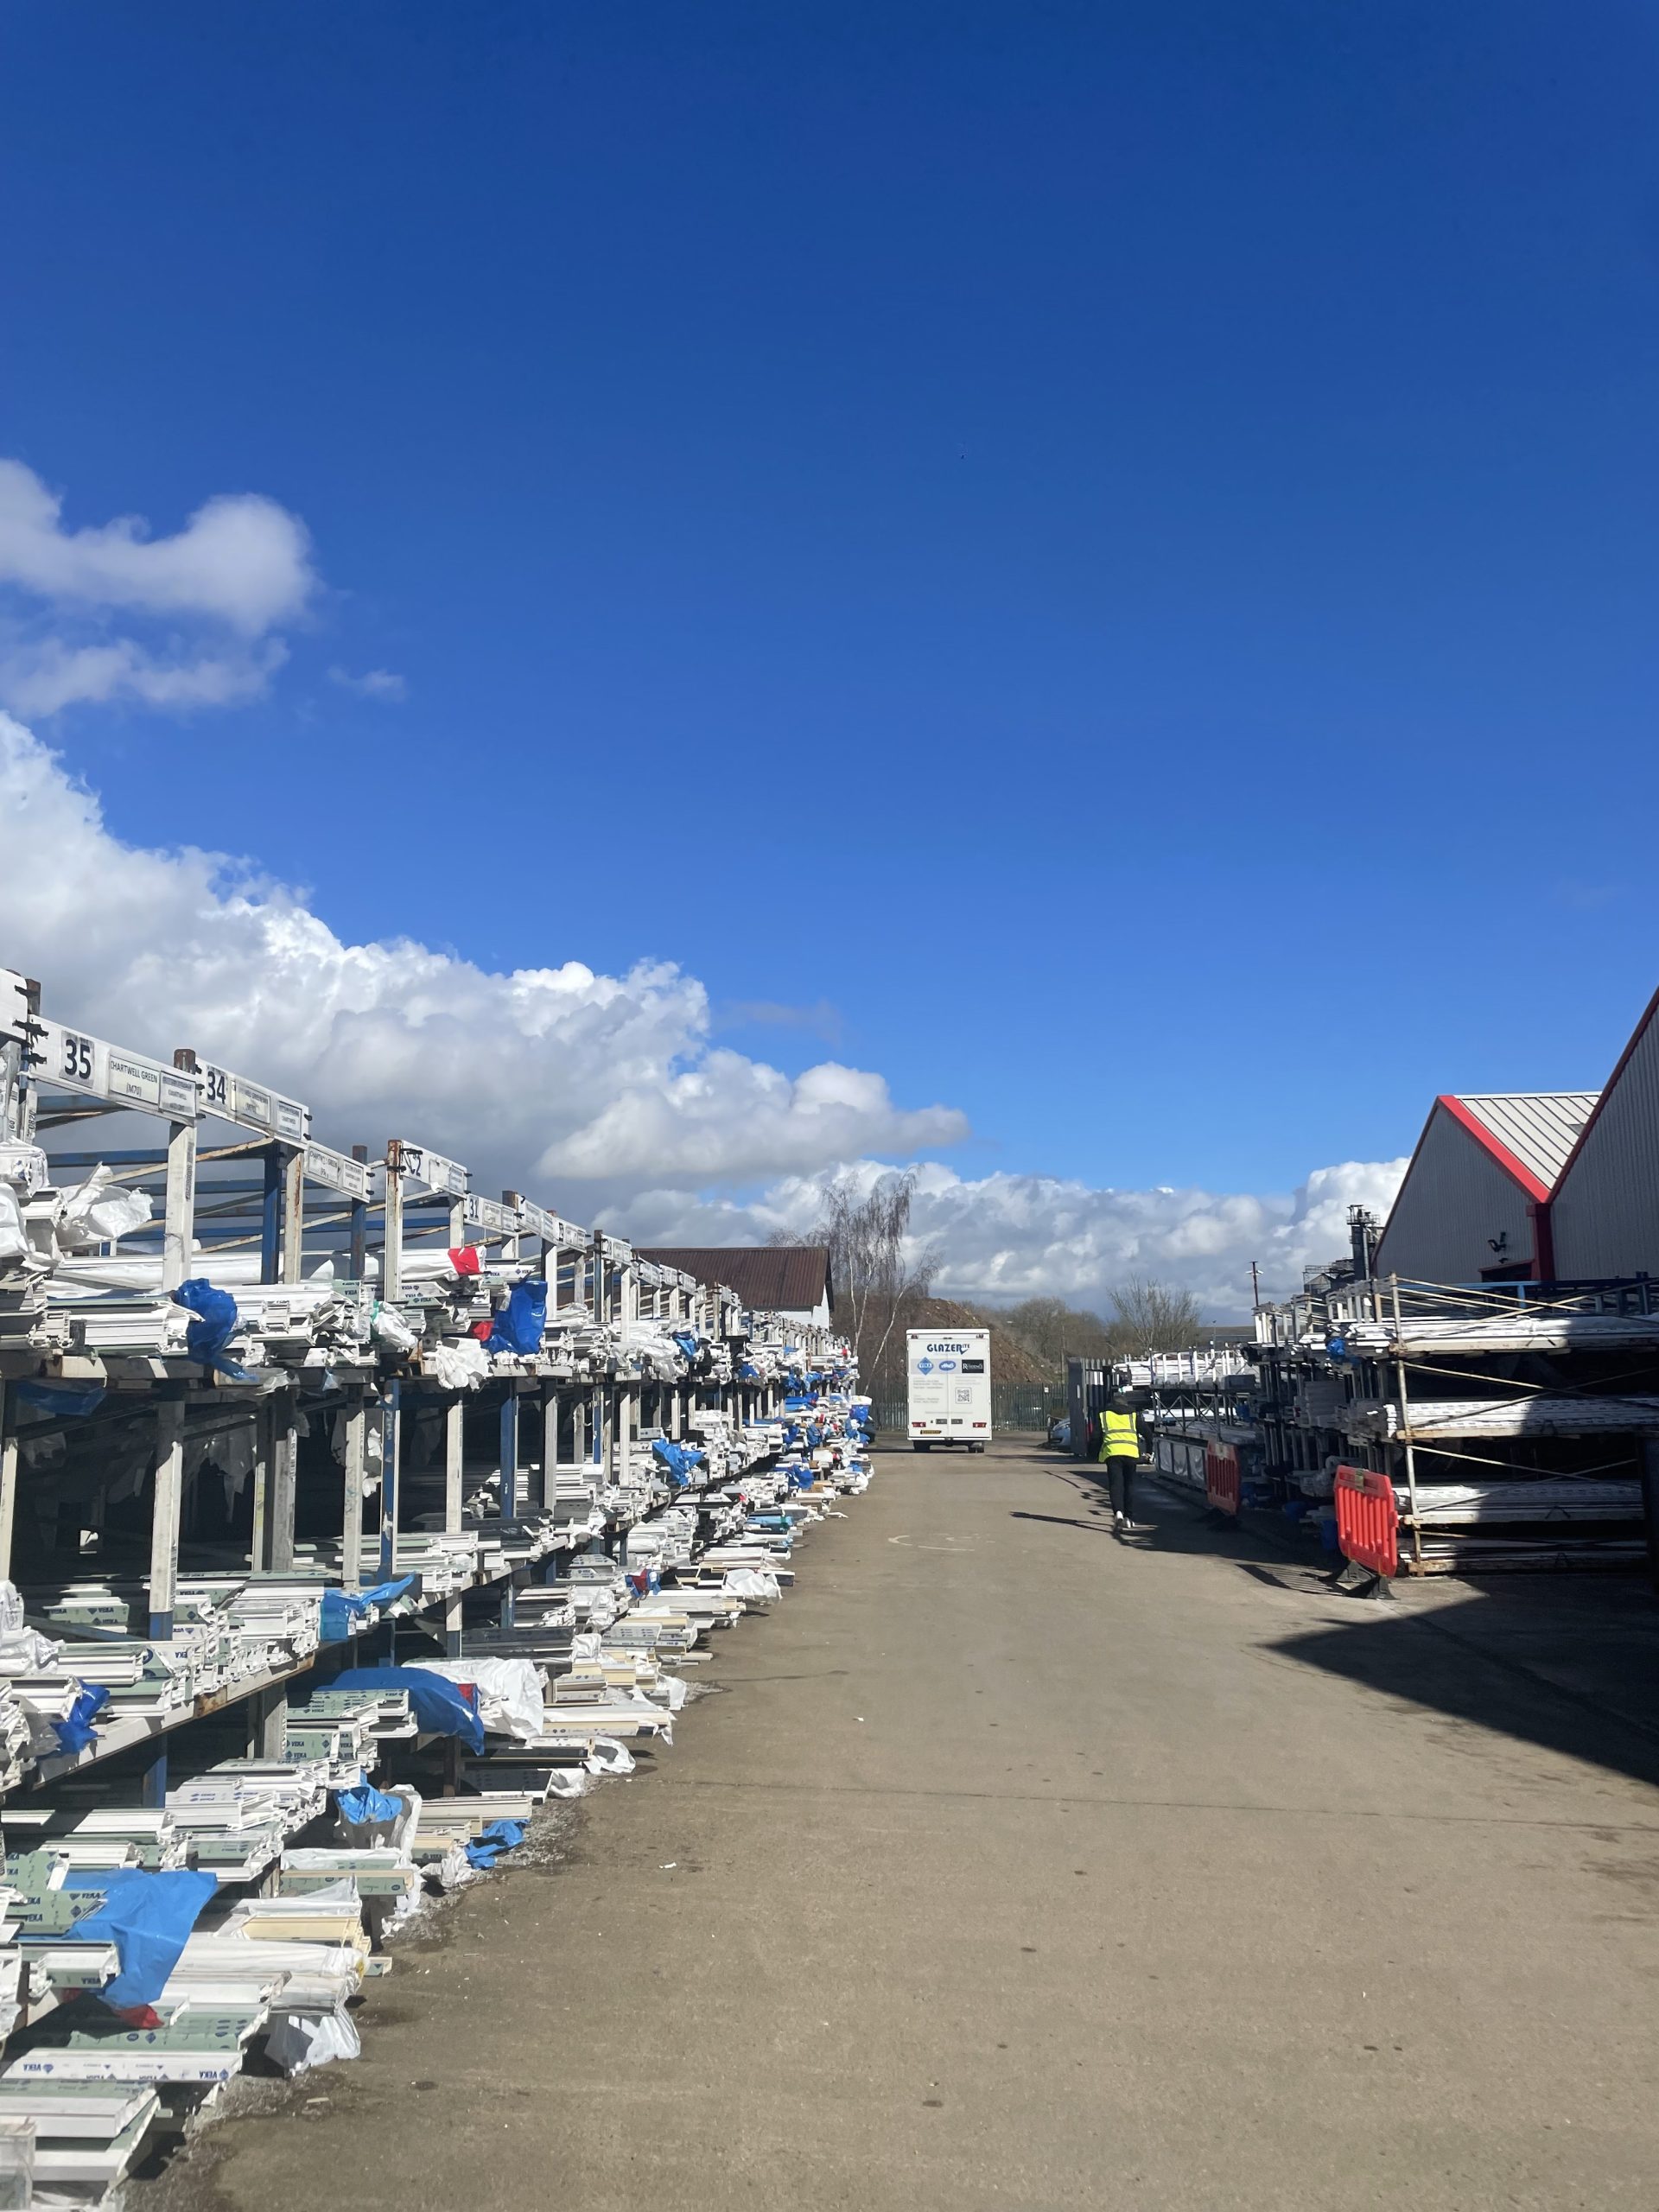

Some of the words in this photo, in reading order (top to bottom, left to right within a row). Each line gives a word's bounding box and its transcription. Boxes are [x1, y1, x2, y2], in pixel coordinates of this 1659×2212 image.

[65, 1039, 91, 1079] 35
[110, 1060, 141, 1078] CHARTWELL
[141, 1071, 158, 1084] GREEN
[207, 1071, 226, 1104] 34
[470, 1198, 479, 1218] 31
[200, 2070, 217, 2079] VEKA
